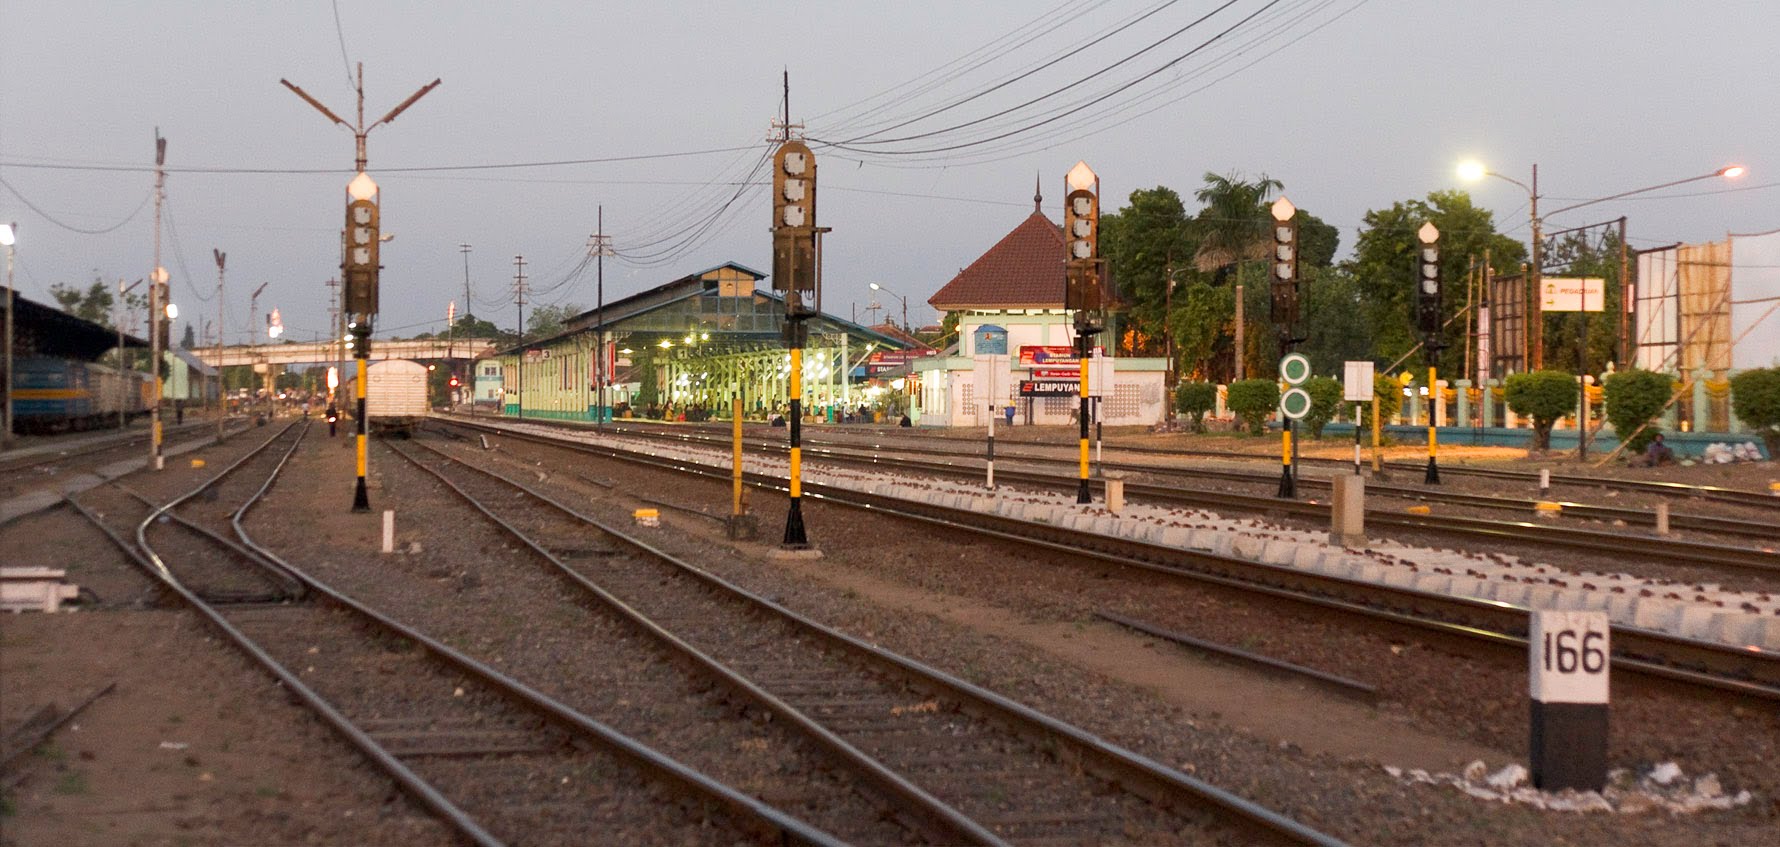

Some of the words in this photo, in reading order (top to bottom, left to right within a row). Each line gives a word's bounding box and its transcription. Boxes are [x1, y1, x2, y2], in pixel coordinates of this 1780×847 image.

[544, 351, 550, 359] 3
[1034, 383, 1081, 392] LEMPUYAN
[1544, 629, 1605, 675] 166
